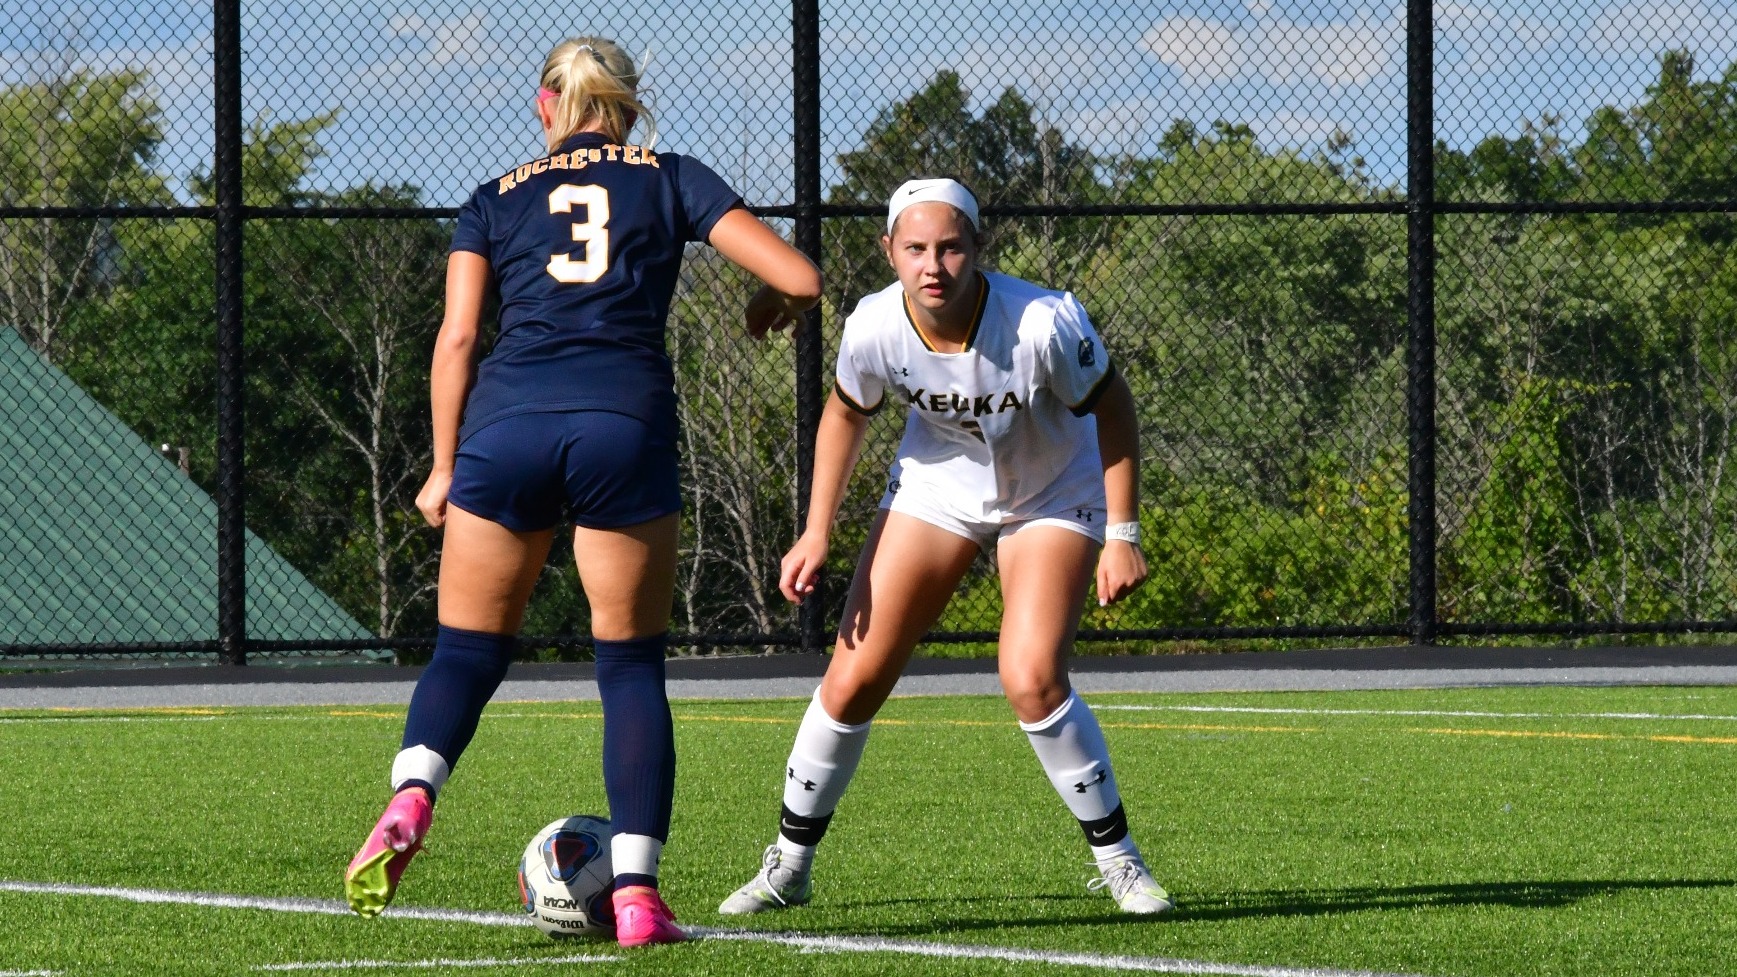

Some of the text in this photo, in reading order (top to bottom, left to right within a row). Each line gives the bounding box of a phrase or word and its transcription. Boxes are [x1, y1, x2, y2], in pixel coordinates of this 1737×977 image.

[498, 144, 660, 195] ROCHESTER
[546, 183, 610, 283] 3
[907, 388, 1023, 418] KEUKA
[543, 895, 579, 910] NCAA
[541, 914, 585, 929] Wilson
